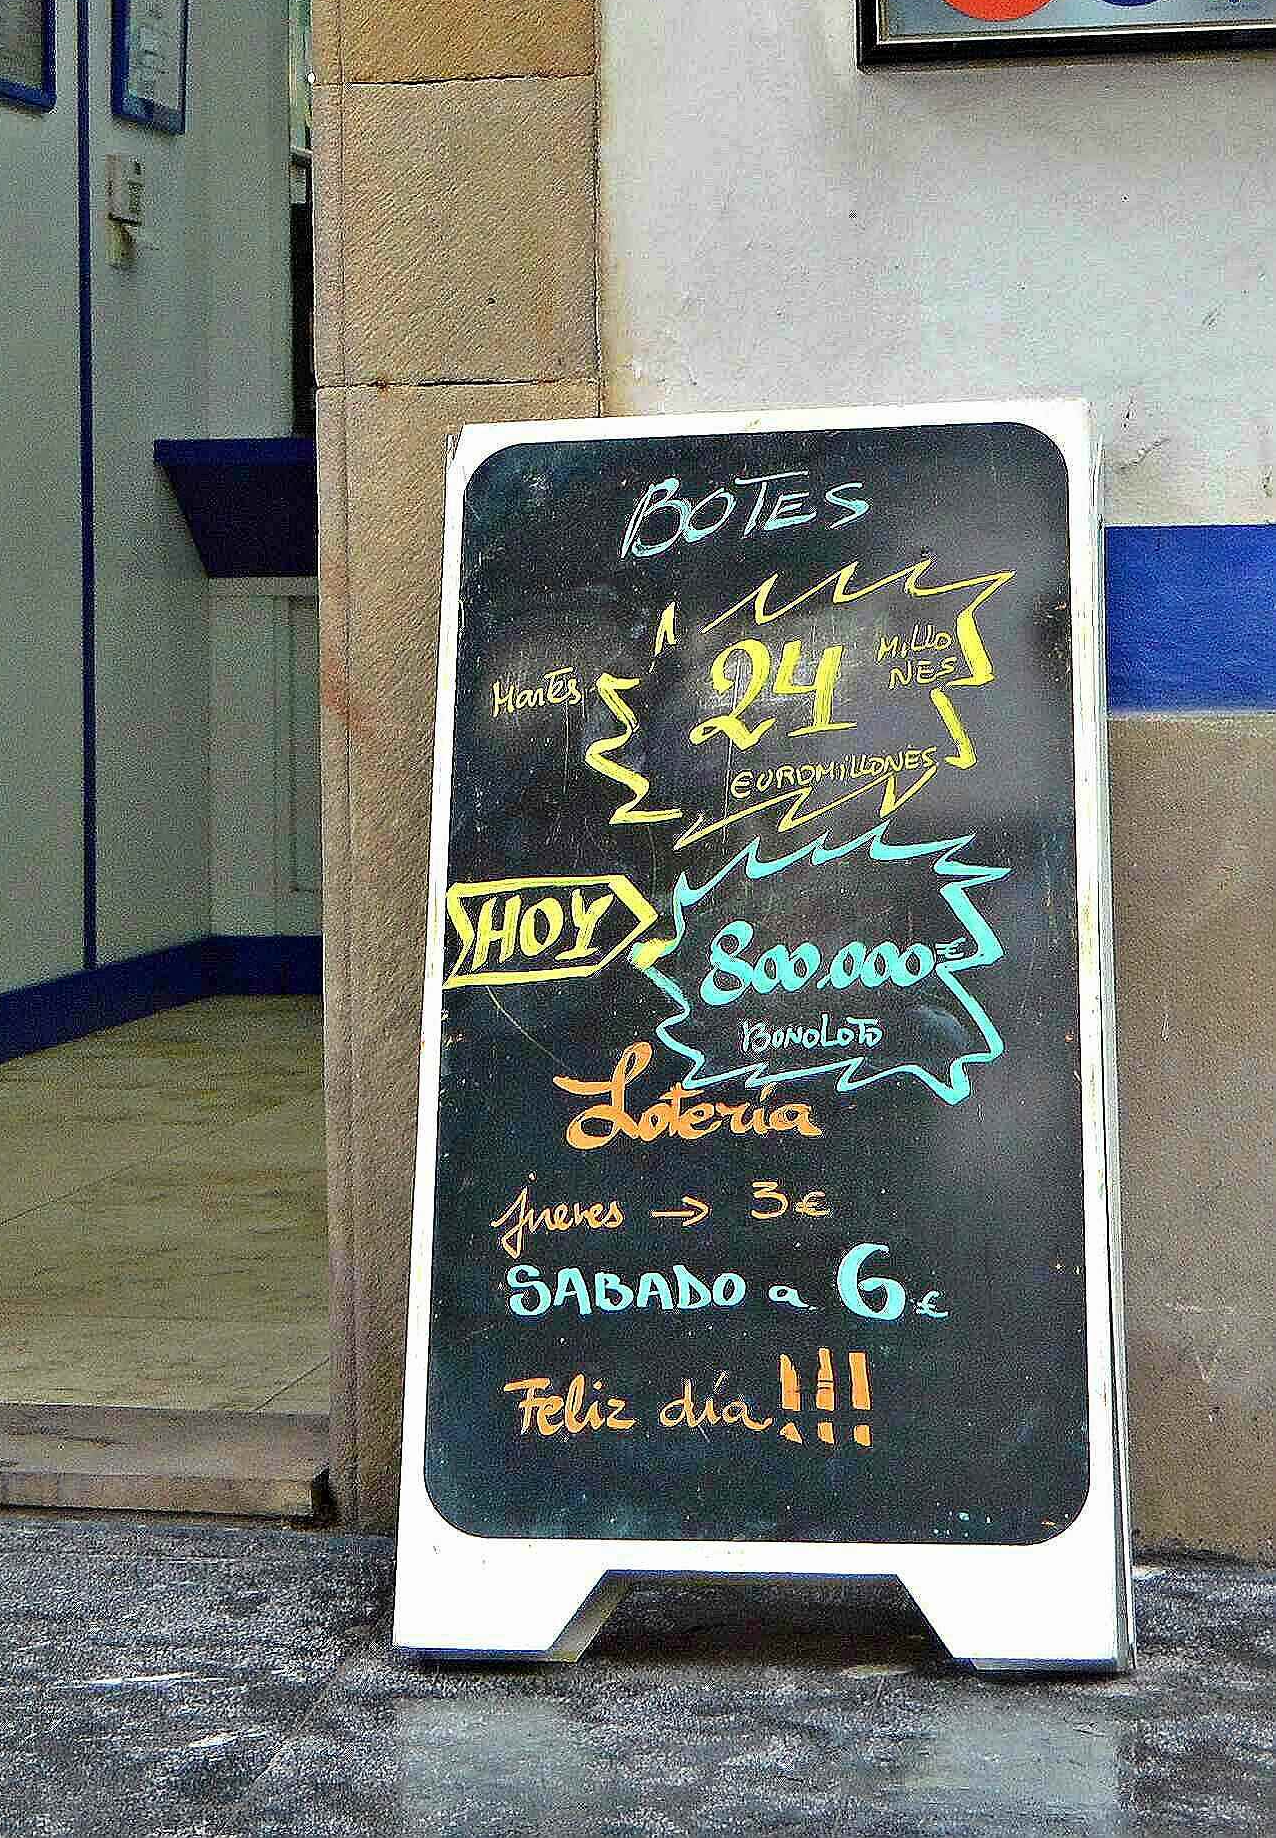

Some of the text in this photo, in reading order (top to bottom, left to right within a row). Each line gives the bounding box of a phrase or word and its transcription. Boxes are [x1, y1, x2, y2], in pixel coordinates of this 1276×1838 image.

[621, 470, 871, 559] BOTES
[690, 638, 856, 750] 24
[889, 657, 957, 690] NES
[471, 888, 614, 972] HOY
[506, 1264, 746, 1318] SABADO
[768, 1284, 815, 1310] a
[503, 1373, 636, 1436] Feliz
